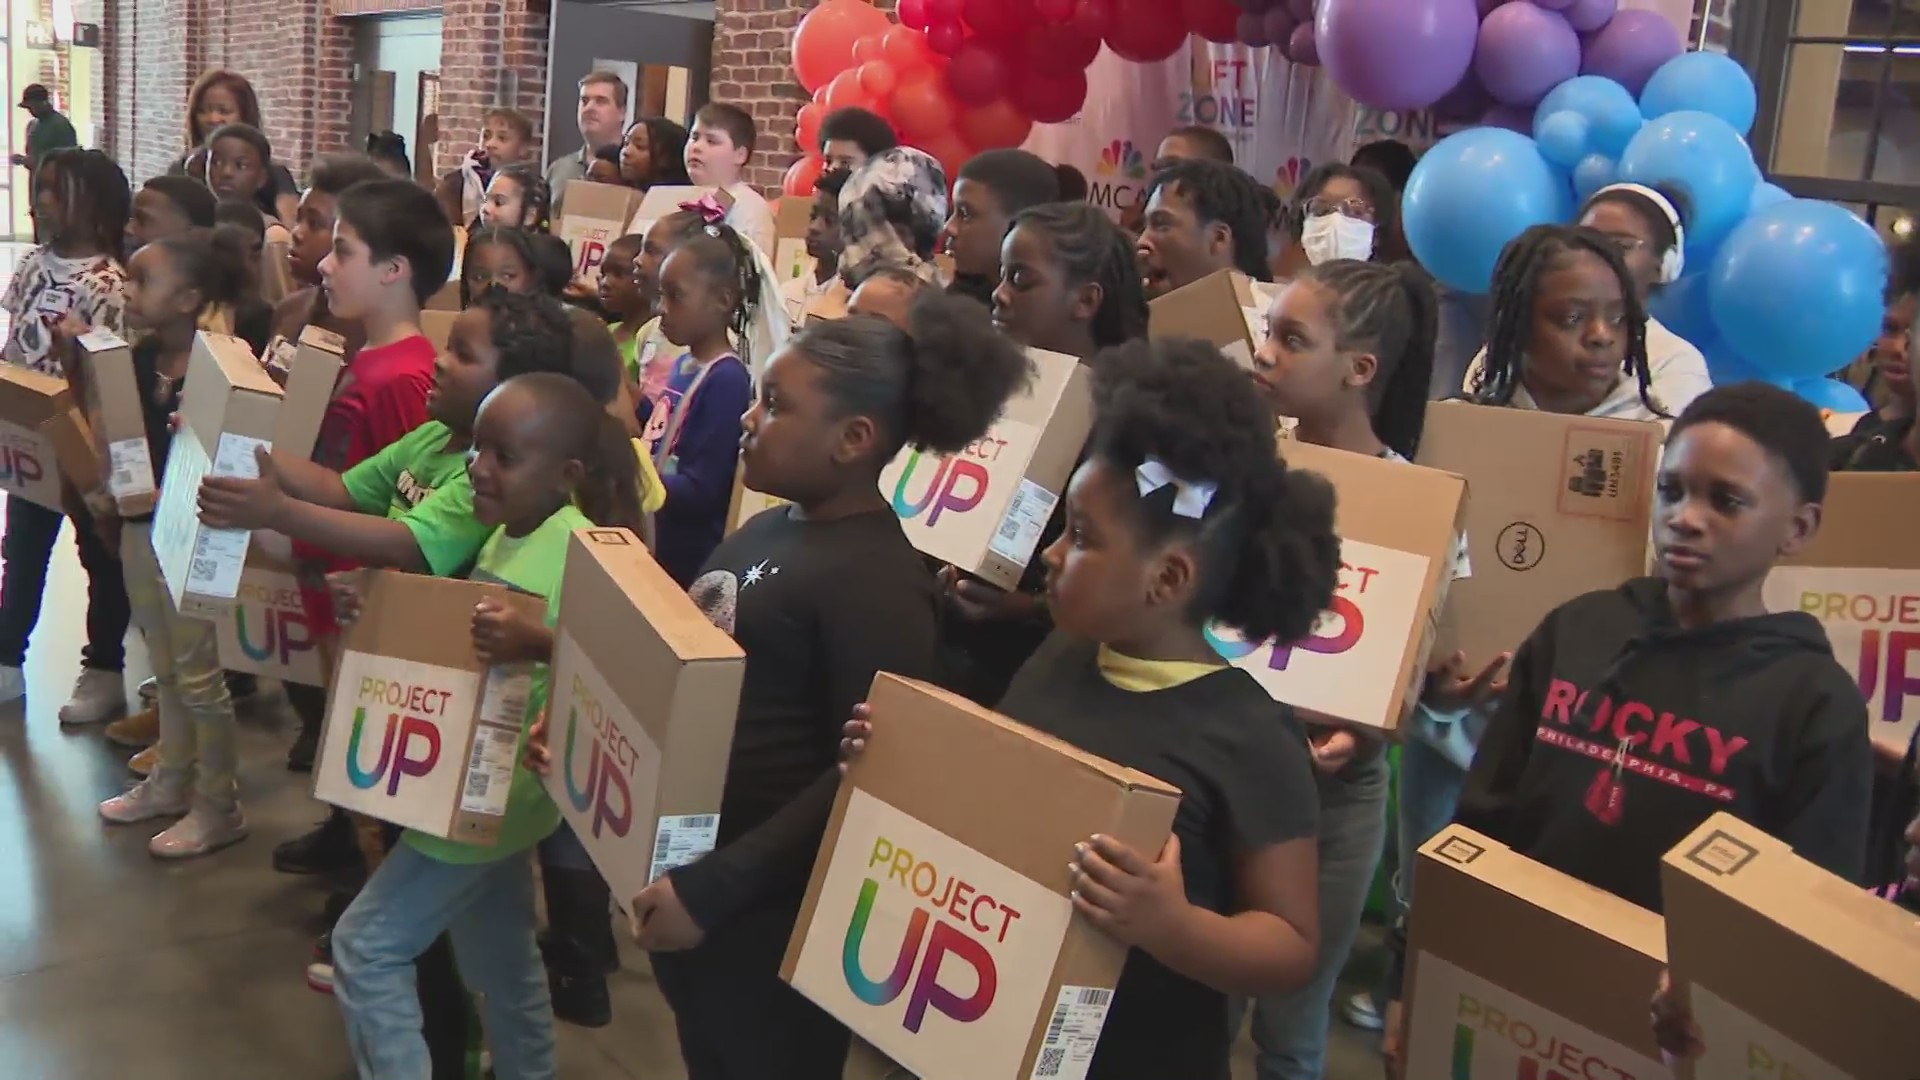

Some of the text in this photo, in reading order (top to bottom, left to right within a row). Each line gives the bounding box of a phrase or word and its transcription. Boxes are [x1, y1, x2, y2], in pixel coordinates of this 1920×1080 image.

[1176, 92, 1255, 128] ZONE
[893, 449, 989, 527] UP
[1513, 528, 1528, 564] DELL
[235, 604, 317, 666] UP
[1801, 591, 1920, 624] PROJE
[357, 675, 453, 716] PROJECT
[573, 672, 640, 777] PROJECT
[1541, 678, 1749, 776] ROCKY
[346, 706, 441, 797] UP
[564, 705, 632, 839] UP
[1704, 783, 1733, 801] PA
[869, 836, 1021, 943] PROJECT
[842, 877, 997, 1034] UP
